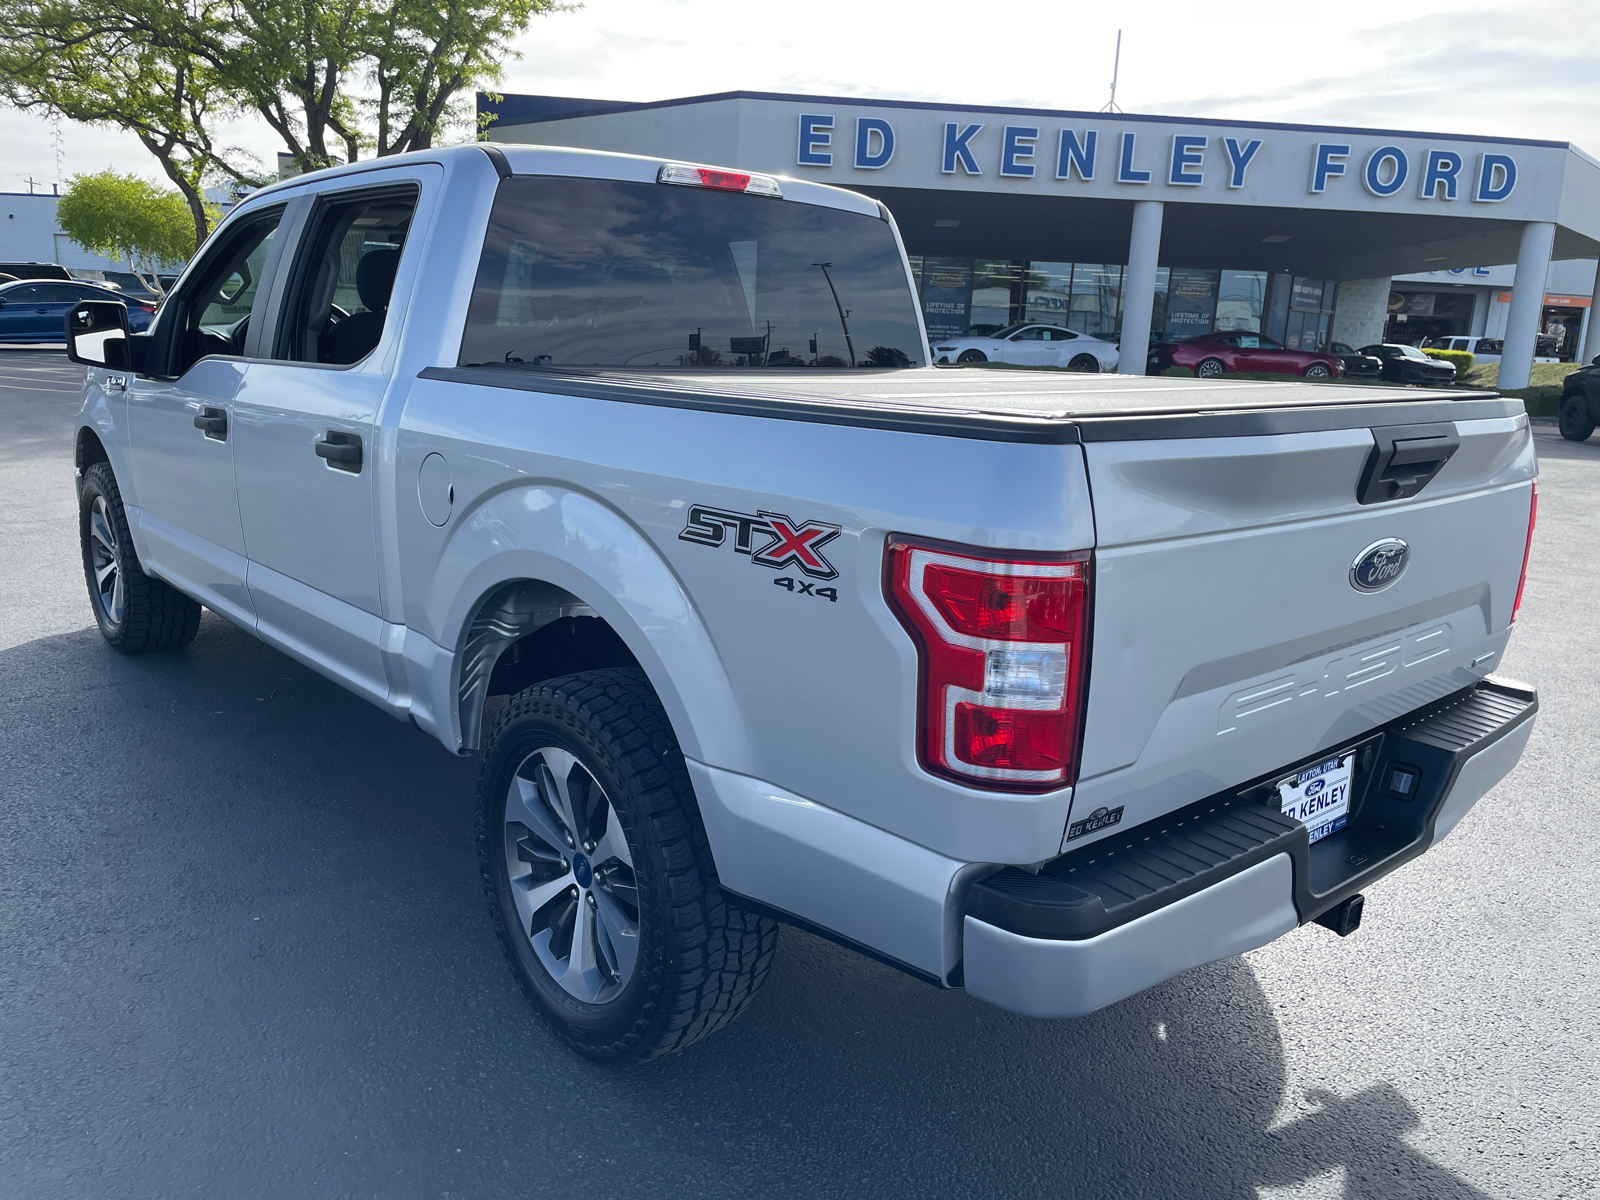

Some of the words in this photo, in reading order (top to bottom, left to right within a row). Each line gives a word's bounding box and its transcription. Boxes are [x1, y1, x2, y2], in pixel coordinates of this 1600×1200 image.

[797, 113, 897, 169] ED
[940, 121, 1264, 189] KENLEY
[1308, 143, 1518, 203] FORD
[678, 503, 843, 582] STX
[1367, 551, 1403, 582] Ford
[1323, 758, 1339, 772] UTAH
[1299, 783, 1347, 820] KENLEY
[1308, 781, 1323, 795] Ford
[1068, 824, 1083, 838] ED
[1085, 810, 1123, 831] KENLEY
[1309, 821, 1334, 842] ENLEY
